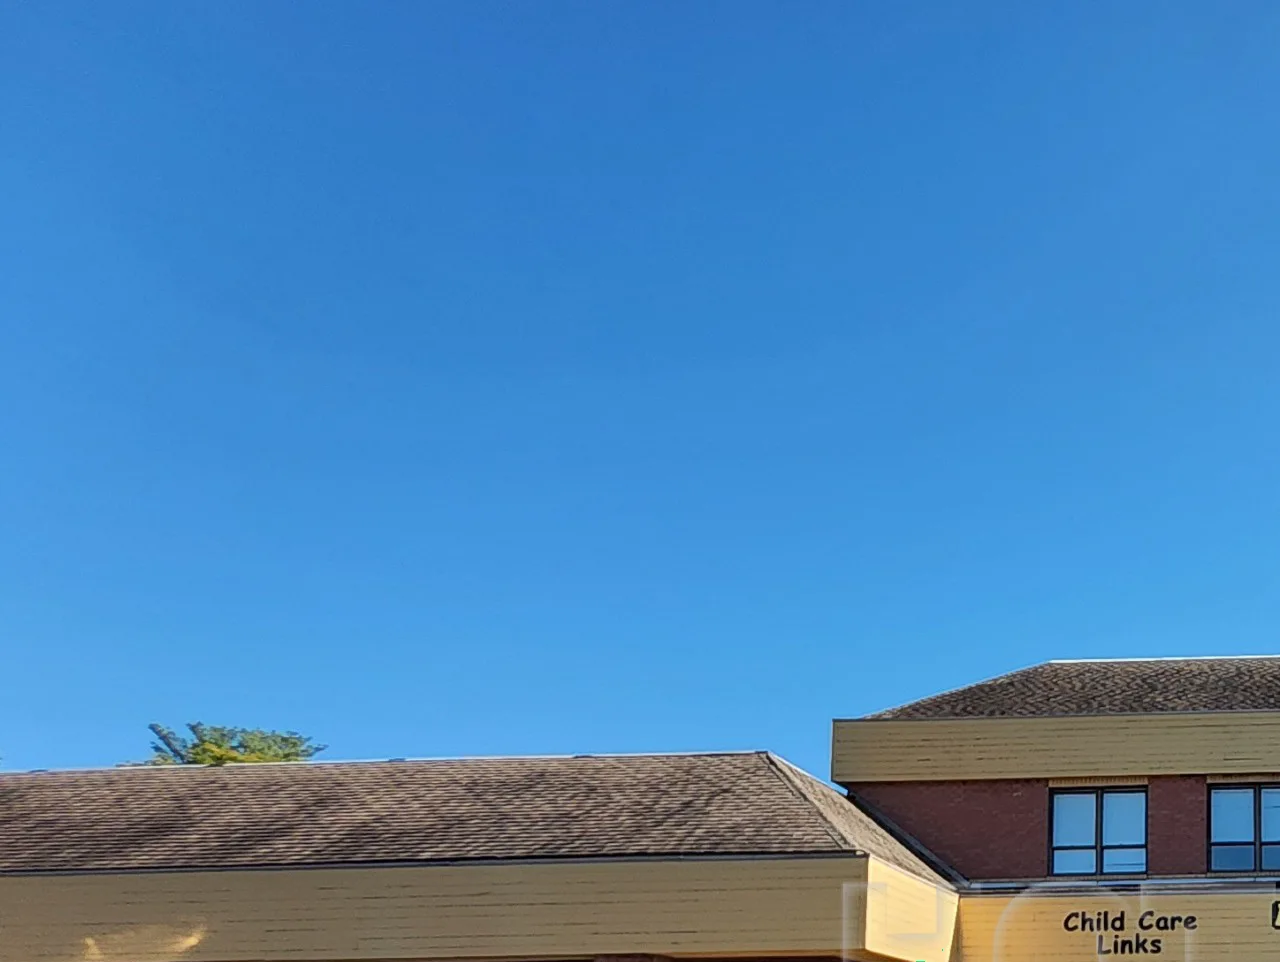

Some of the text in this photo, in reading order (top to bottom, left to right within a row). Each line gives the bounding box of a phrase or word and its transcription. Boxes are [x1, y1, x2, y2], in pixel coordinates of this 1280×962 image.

[1063, 910, 1198, 932] Child Care
[1097, 932, 1162, 955] Links
